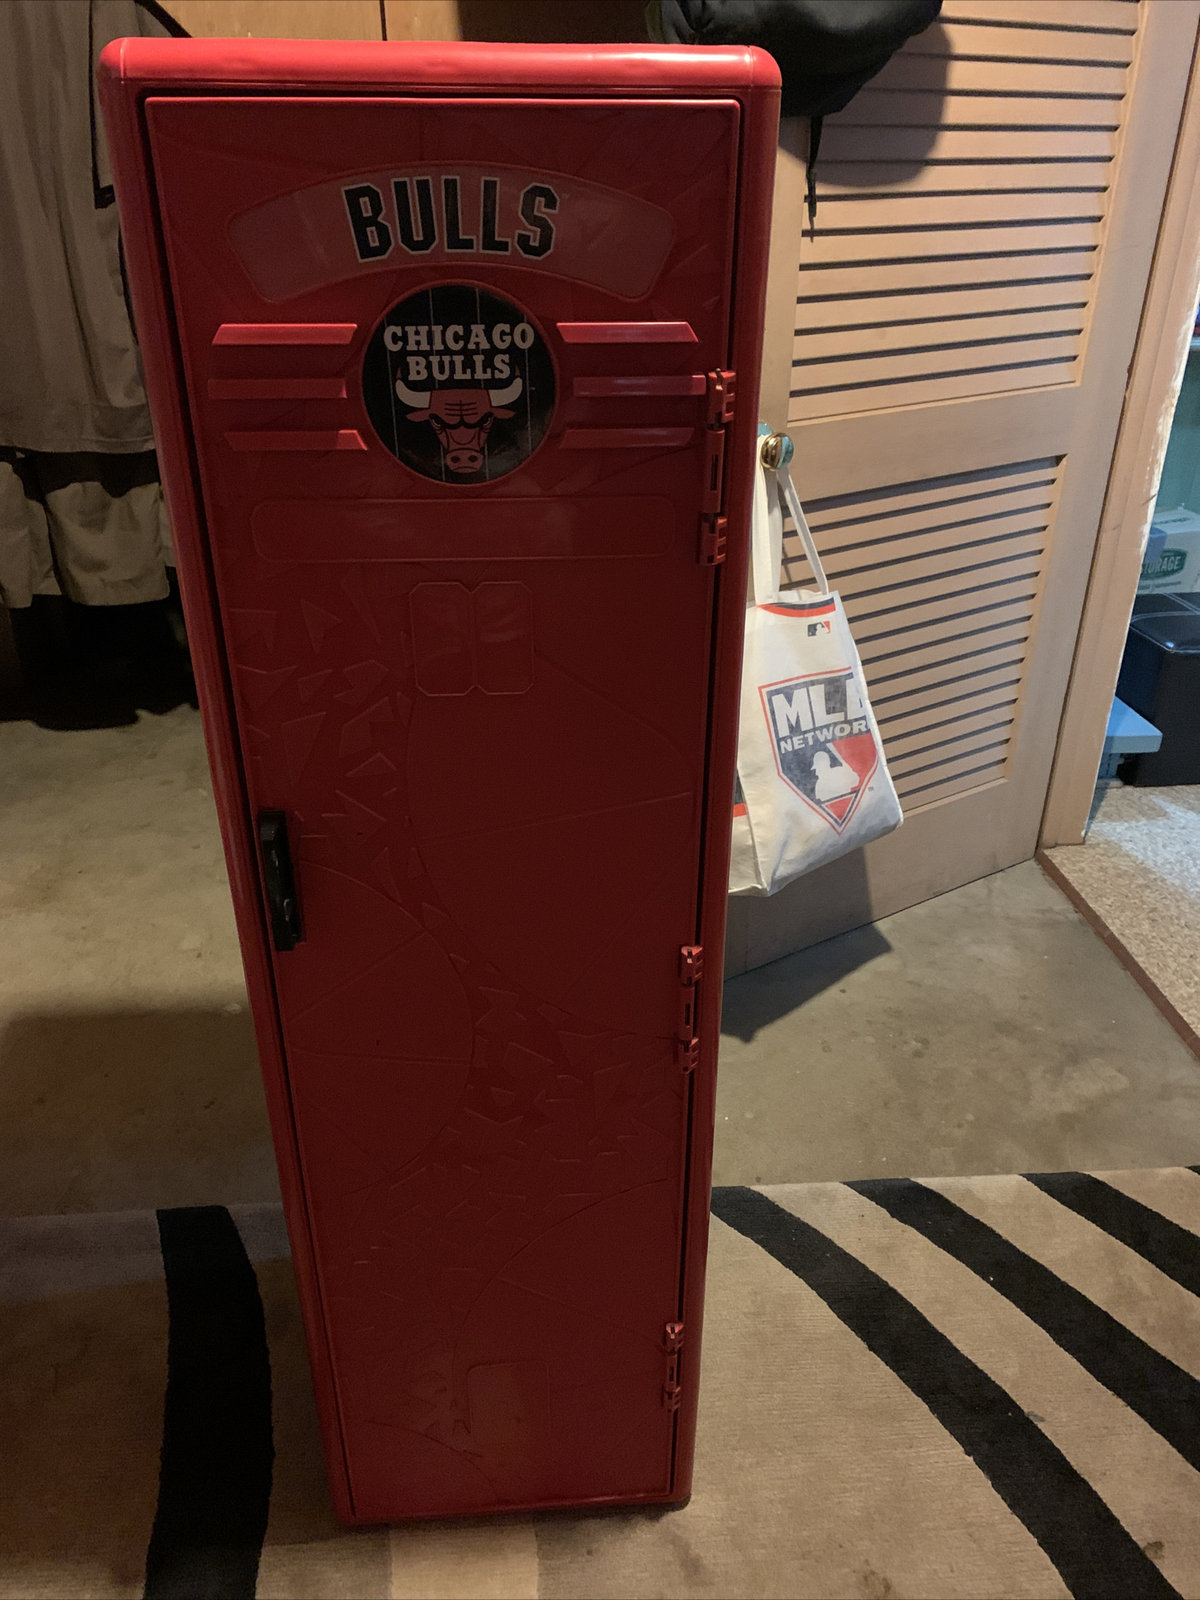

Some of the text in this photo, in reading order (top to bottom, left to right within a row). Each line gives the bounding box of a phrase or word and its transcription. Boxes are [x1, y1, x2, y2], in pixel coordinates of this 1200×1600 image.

[342, 176, 559, 262] BULLS
[384, 323, 535, 351] CHICAGO
[406, 355, 511, 380] BULLS
[1143, 556, 1181, 573] TORAGE
[780, 719, 867, 754] NETWOR
